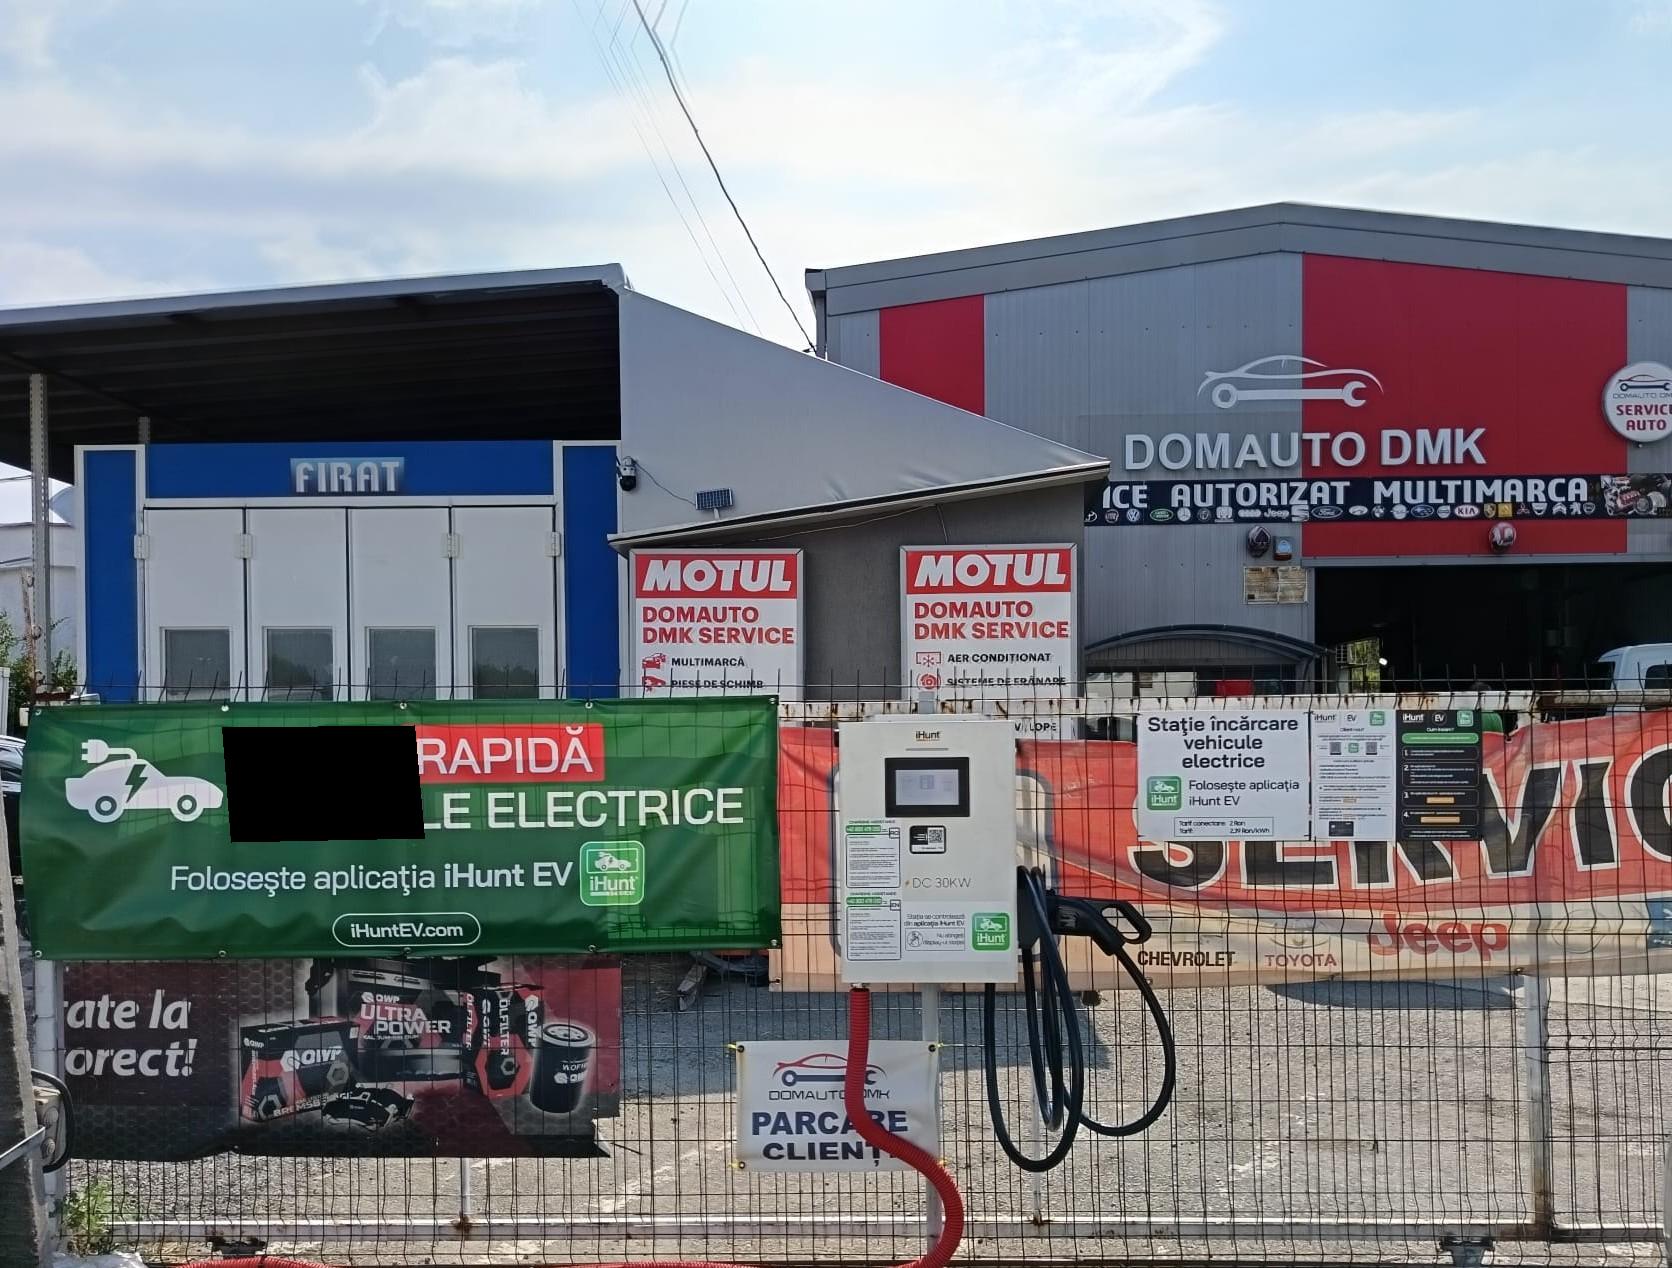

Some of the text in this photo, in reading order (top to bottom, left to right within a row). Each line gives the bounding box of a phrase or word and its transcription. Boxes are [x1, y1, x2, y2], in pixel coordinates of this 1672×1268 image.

[1626, 419, 1667, 431] AUTO
[1124, 428, 1487, 470] DOMAUTO DMK
[295, 461, 401, 493] FIRAT
[1170, 480, 1350, 507] AUTORIZAT
[1374, 477, 1588, 503] MULTIMARCA
[642, 558, 792, 592] MOTUL
[914, 553, 1066, 587] MOTUL
[642, 606, 759, 623] DOMAUTO
[914, 600, 1033, 619] DOMAUTO
[642, 626, 795, 644] DMK SERVICE
[914, 621, 1069, 640] DMK SERVICE
[671, 656, 745, 666] MULTIMARCĂ
[947, 654, 970, 663] AER
[672, 680, 763, 689] PIESE DE SCHIMB
[947, 677, 995, 687] SISTEME
[997, 677, 1012, 686] DE
[1209, 716, 1298, 732] încărcare
[1347, 714, 1357, 722] EV
[1402, 713, 1424, 721] iHunt
[1434, 714, 1445, 722] EV
[915, 731, 940, 739] iHunt
[1184, 735, 1263, 750] vehicule
[415, 726, 592, 775] RAPIDĂ
[1182, 754, 1265, 769] electrice
[487, 787, 744, 829] ELECTRICE
[1189, 796, 1240, 806] iHunt EV
[443, 862, 524, 888] iHunt
[533, 862, 573, 887] EV
[589, 876, 636, 891] iHunt
[912, 877, 971, 889] DC 30KW
[350, 922, 463, 938] iHuntEV.com
[1366, 913, 1509, 962] Jeep
[976, 933, 1005, 944] iHunt
[1137, 951, 1235, 966] CHEVROLET
[1265, 953, 1337, 967] TOYOTA
[64, 989, 192, 1030] ate la
[360, 1003, 428, 1021] ULTRA
[374, 1020, 451, 1035] POWER
[64, 1038, 198, 1077] orect!
[863, 1089, 890, 1100] MK
[762, 1141, 894, 1166] CLIENȚ
